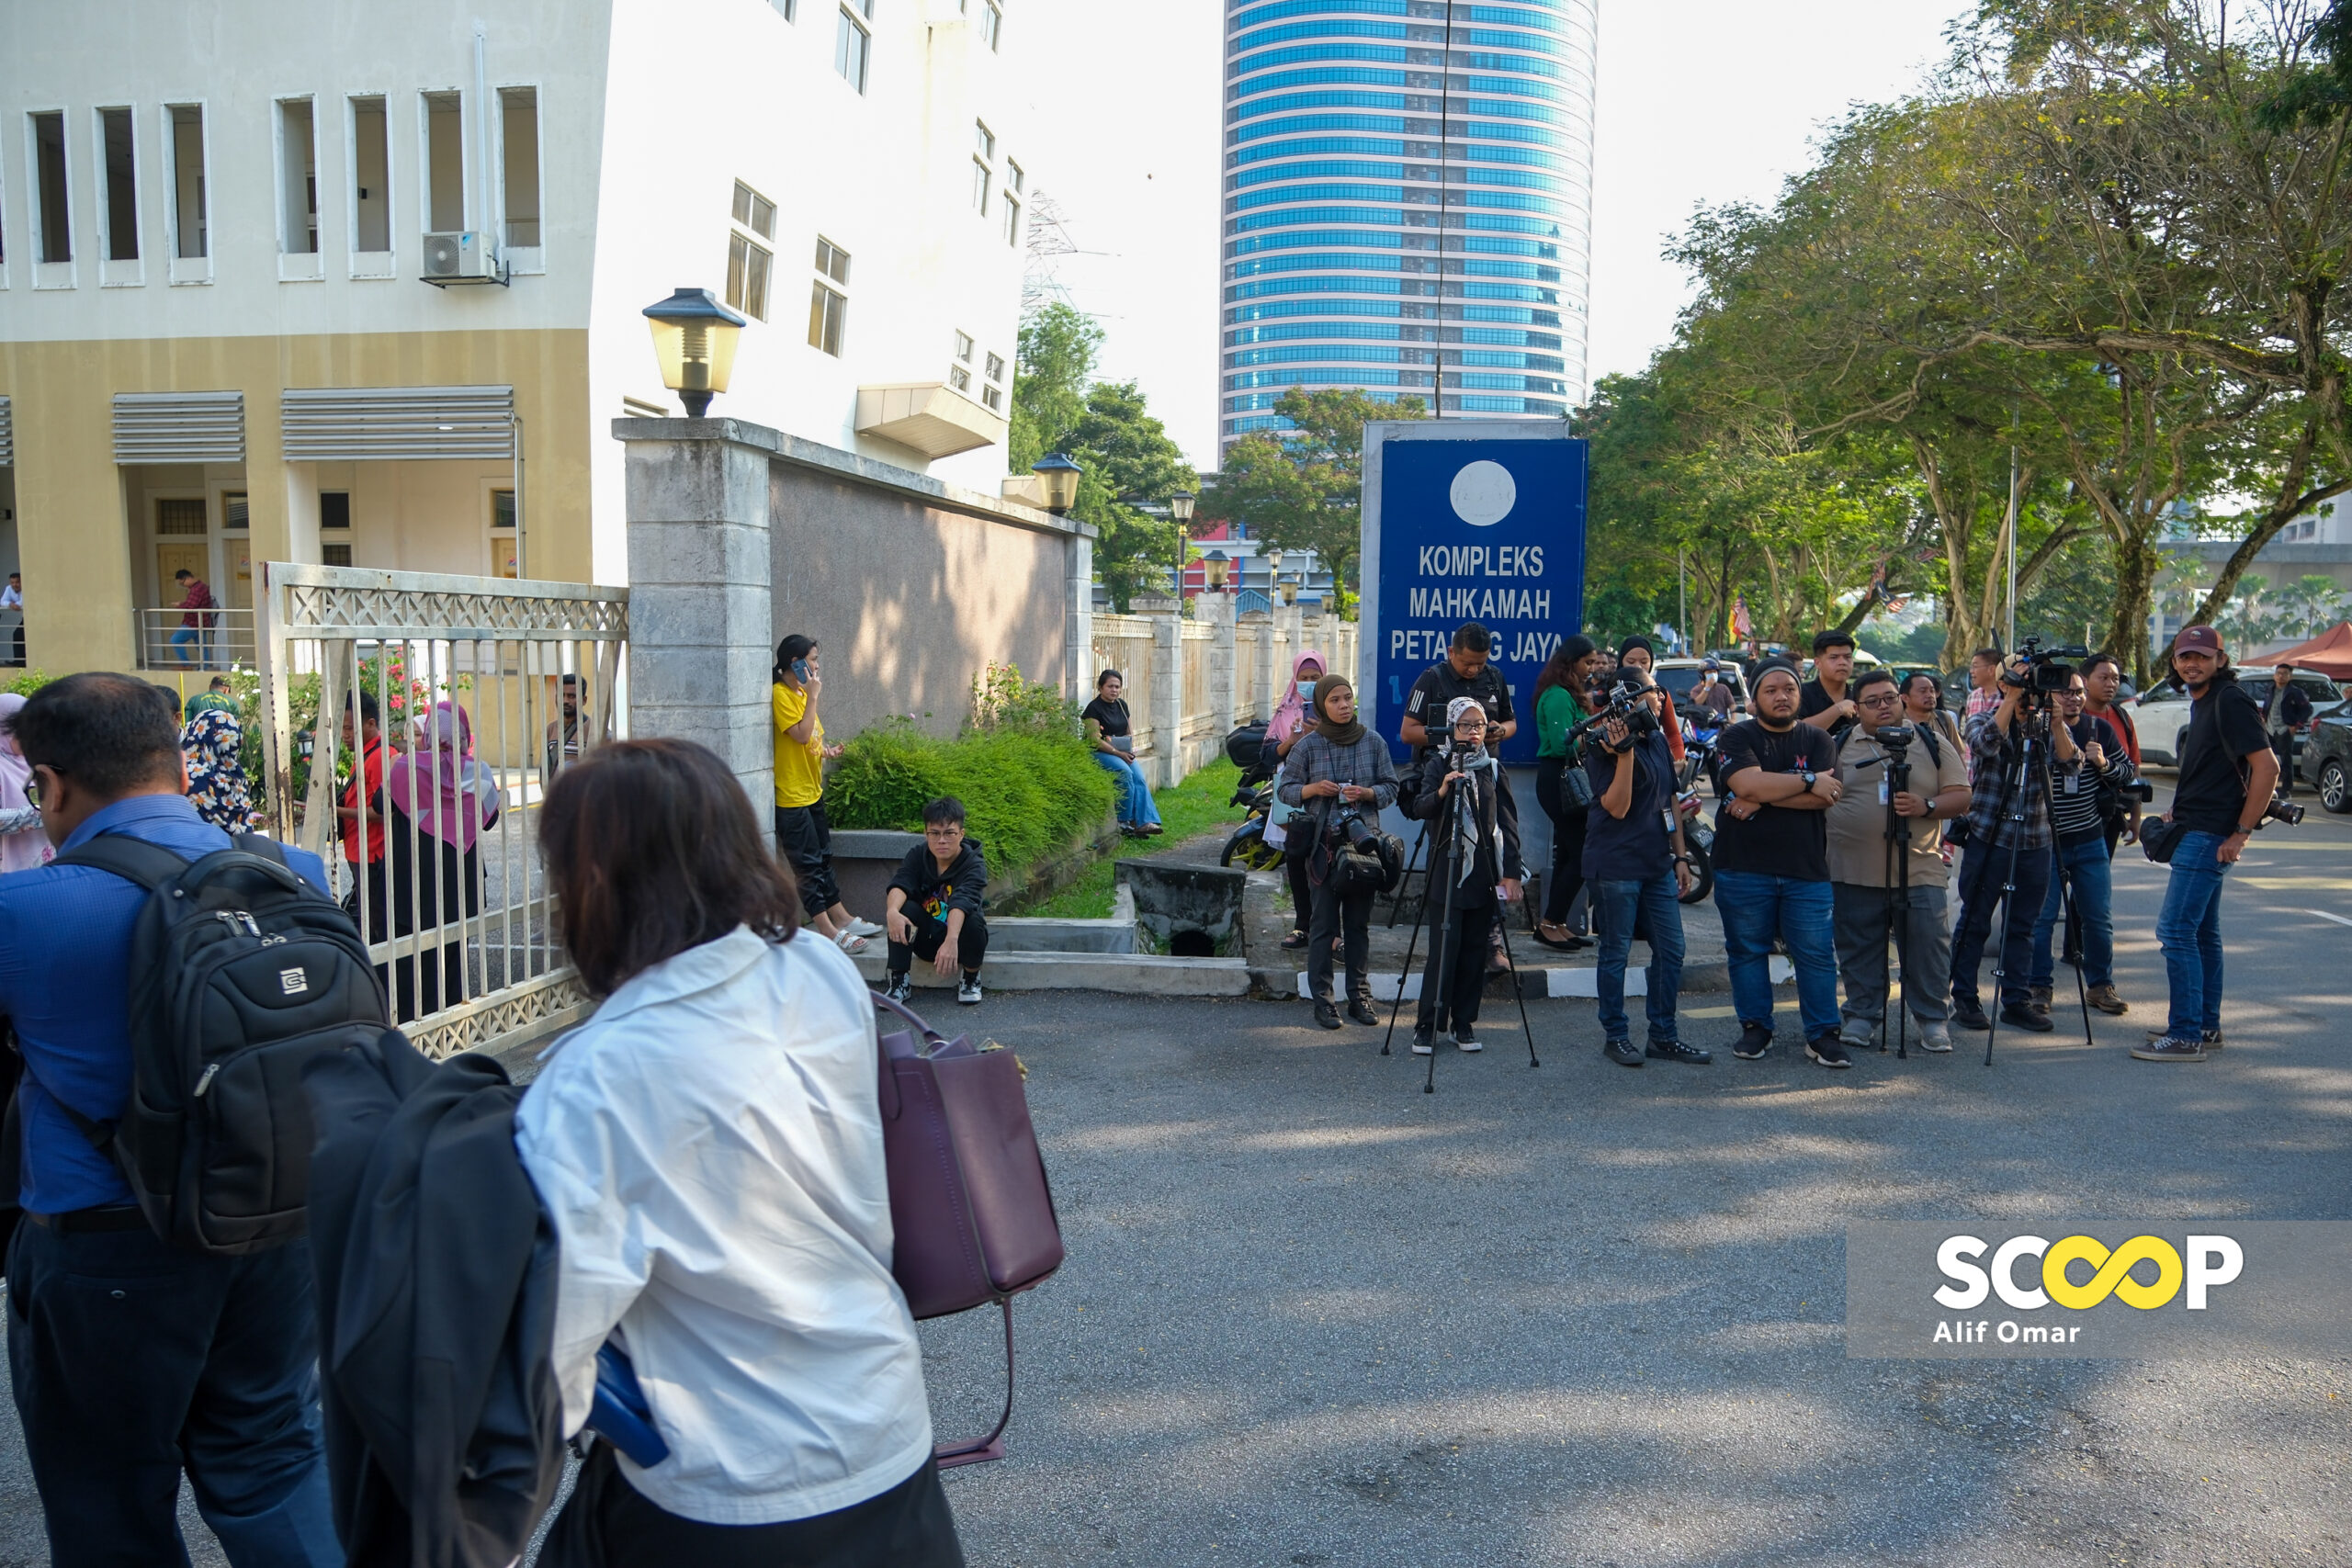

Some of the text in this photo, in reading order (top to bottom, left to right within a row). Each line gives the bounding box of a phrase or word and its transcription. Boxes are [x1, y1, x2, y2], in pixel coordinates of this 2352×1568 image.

[1419, 546, 1544, 577] KOMPLEKS
[1409, 588, 1551, 619] MAHKAMAH
[1391, 629, 1502, 661] PETAG
